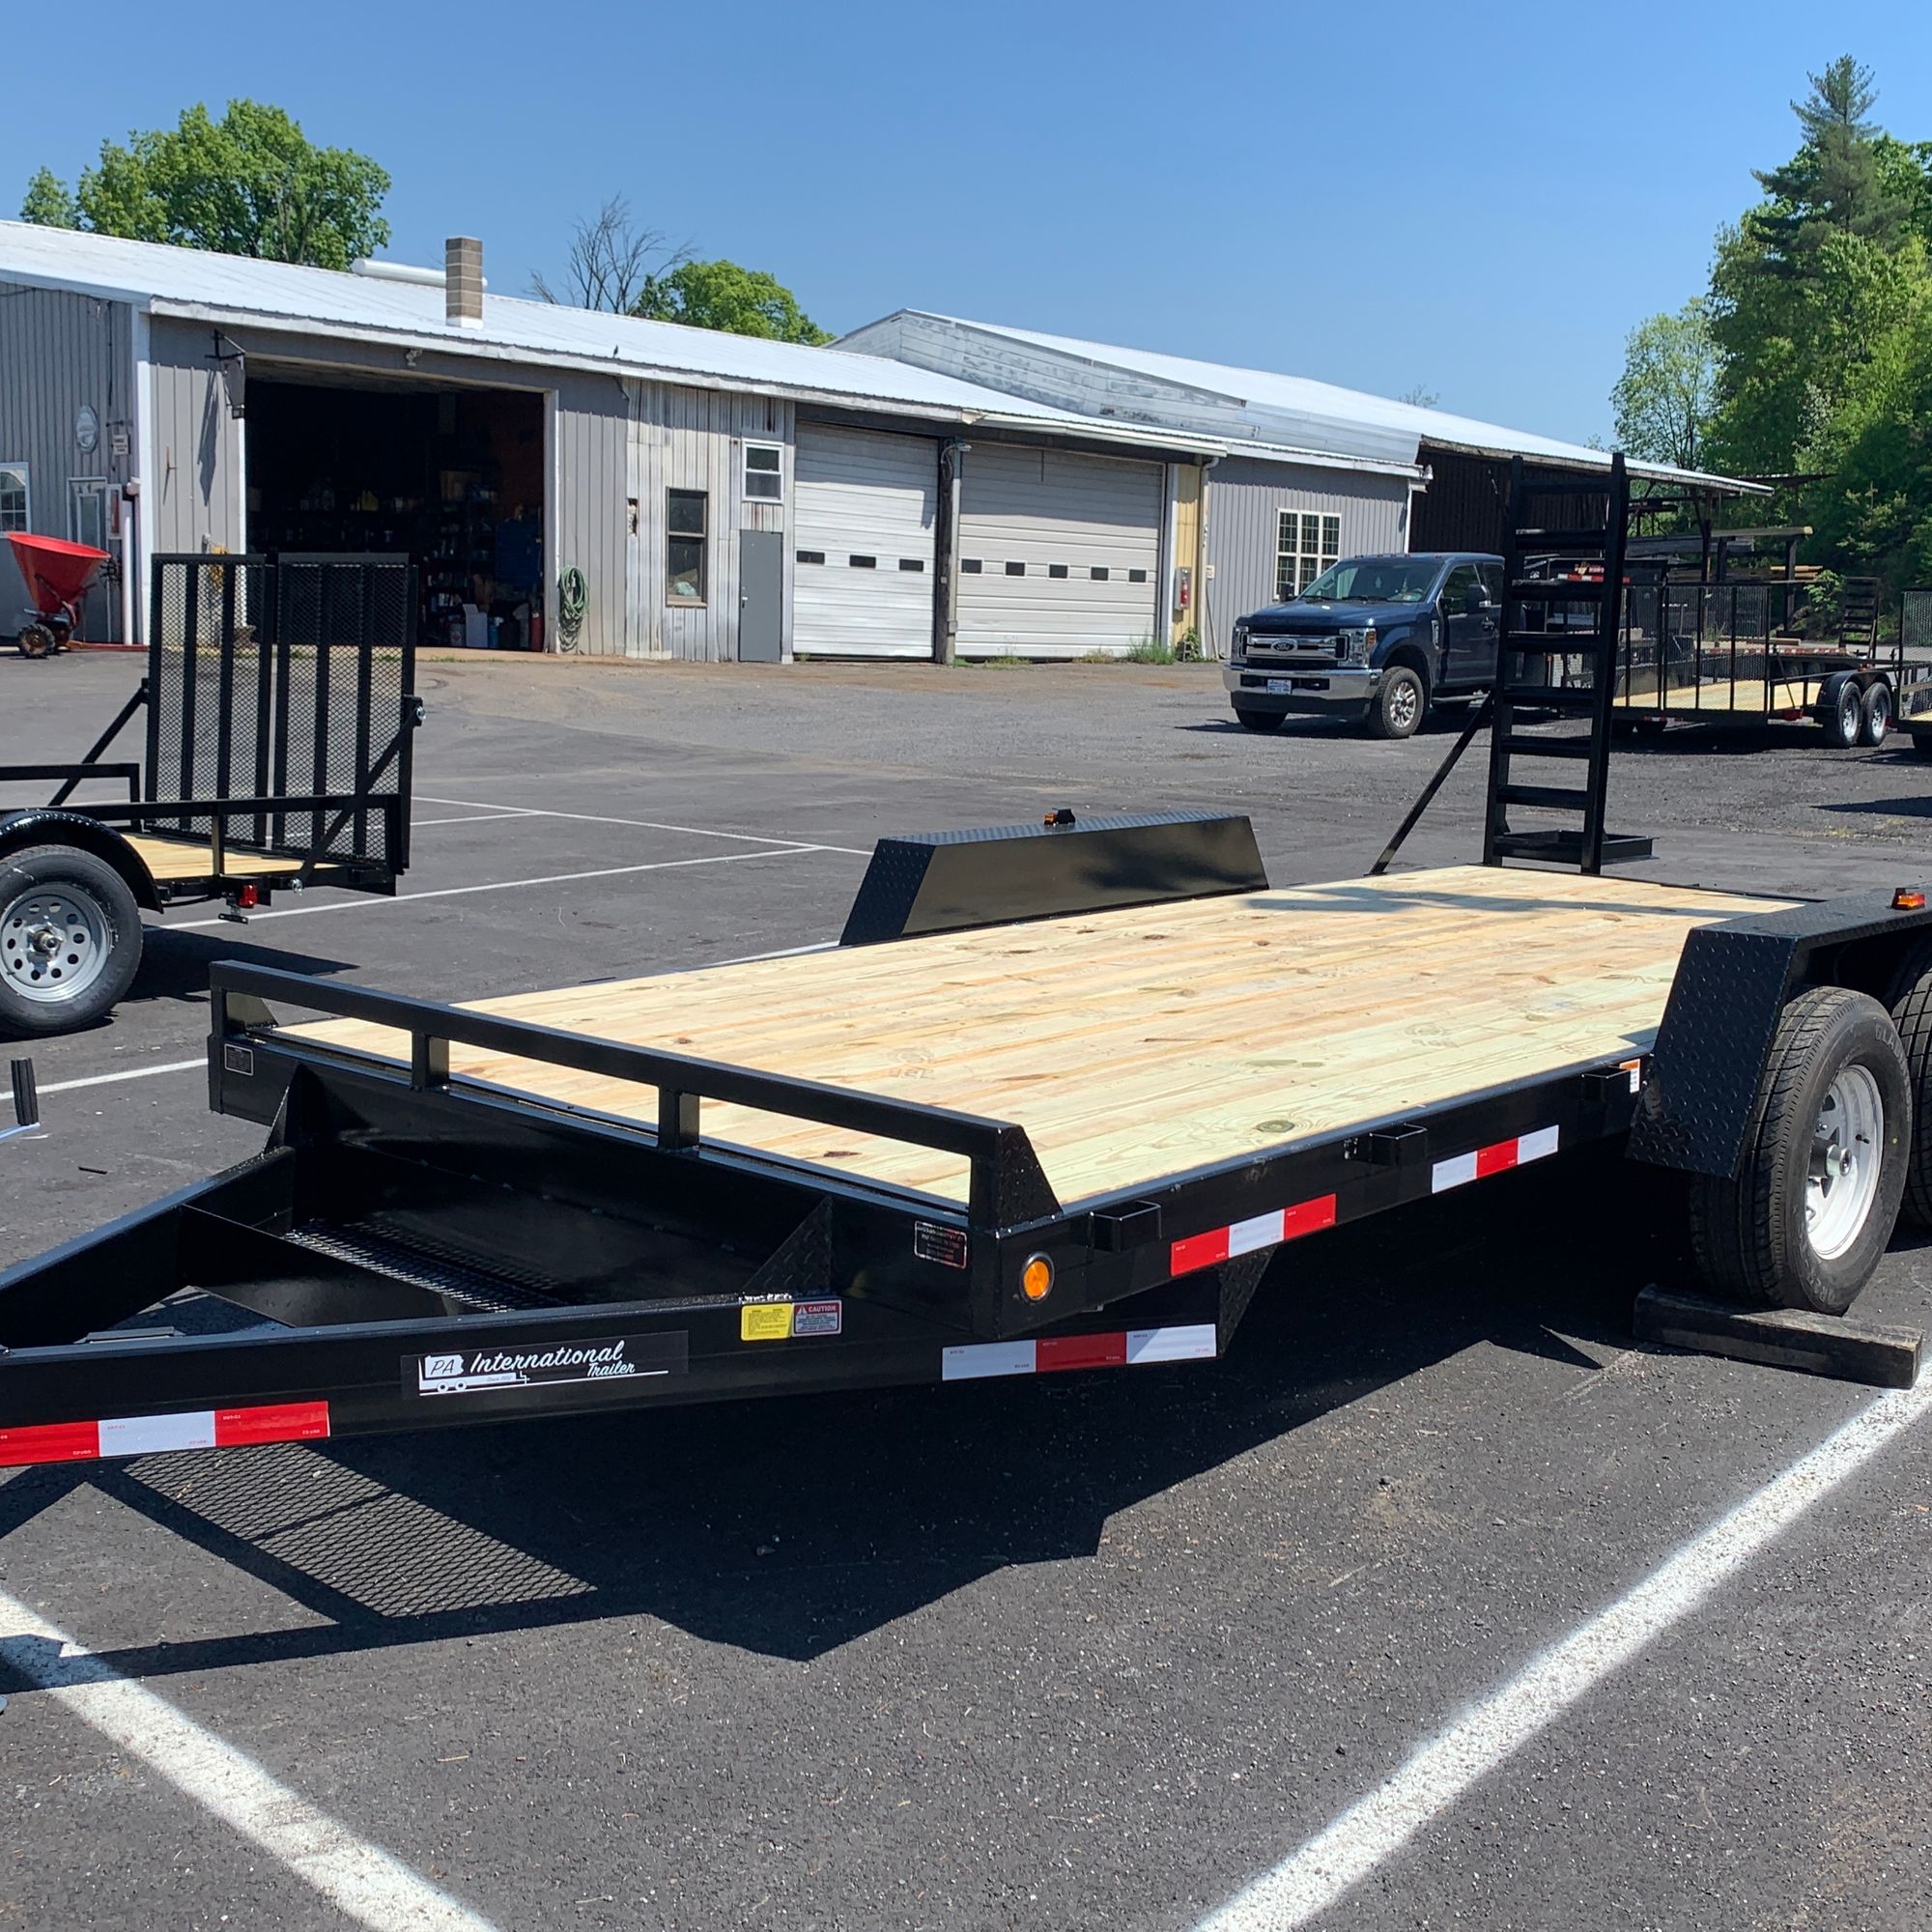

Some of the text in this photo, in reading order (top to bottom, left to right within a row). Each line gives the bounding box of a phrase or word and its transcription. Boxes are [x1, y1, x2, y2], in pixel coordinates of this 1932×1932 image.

[430, 1340, 625, 1376] PA International
[587, 1360, 636, 1377] Trailer
